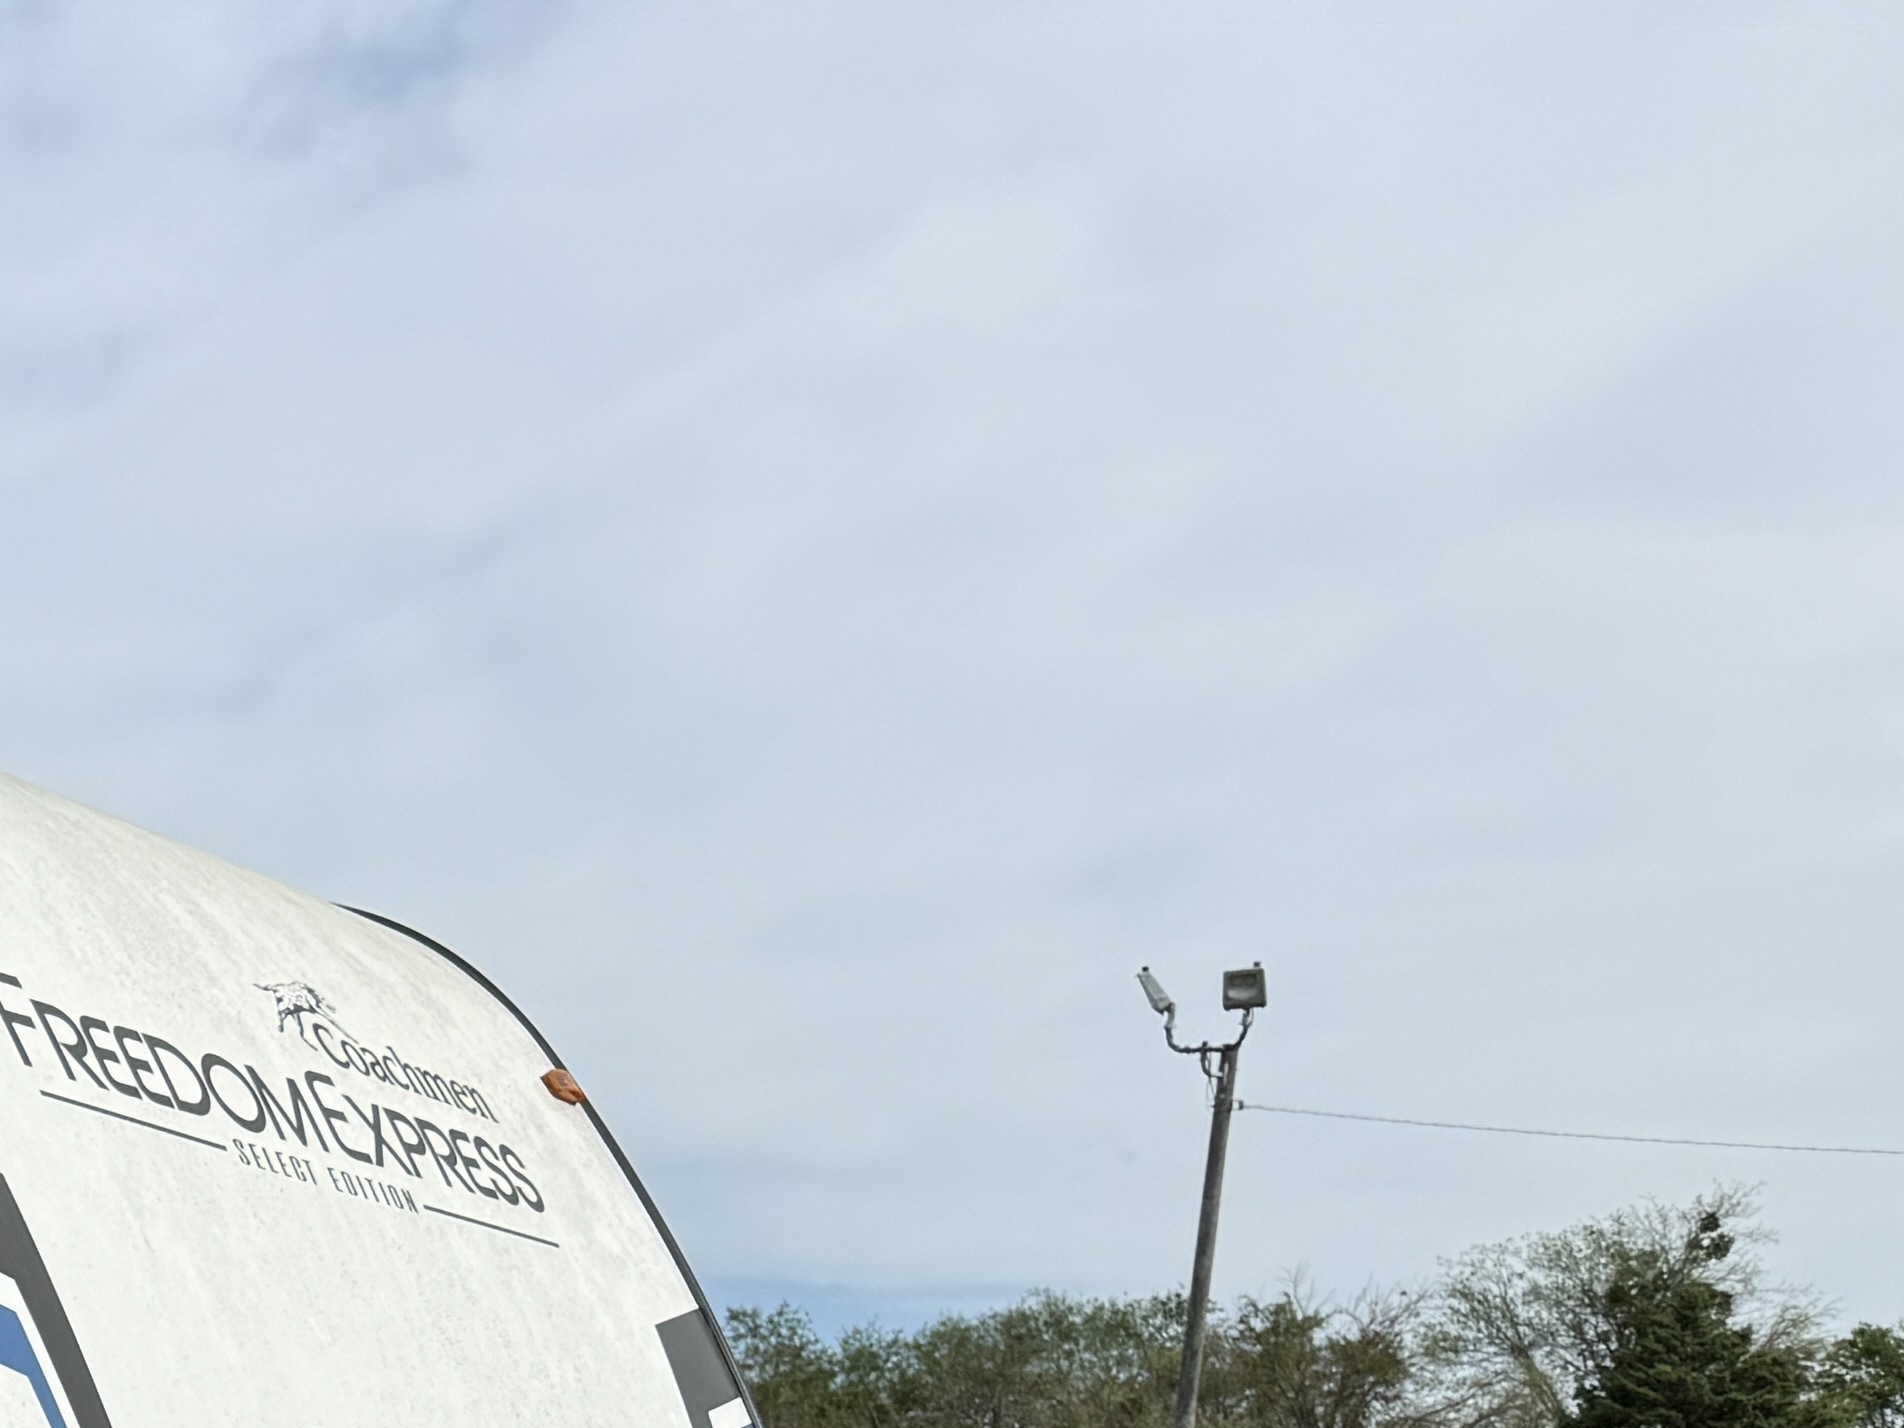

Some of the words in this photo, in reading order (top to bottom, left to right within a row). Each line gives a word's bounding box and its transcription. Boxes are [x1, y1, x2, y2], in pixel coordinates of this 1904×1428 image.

[312, 1021, 500, 1124] Coachmen
[230, 1137, 317, 1186] SELECT
[327, 1166, 420, 1215] EDITION
